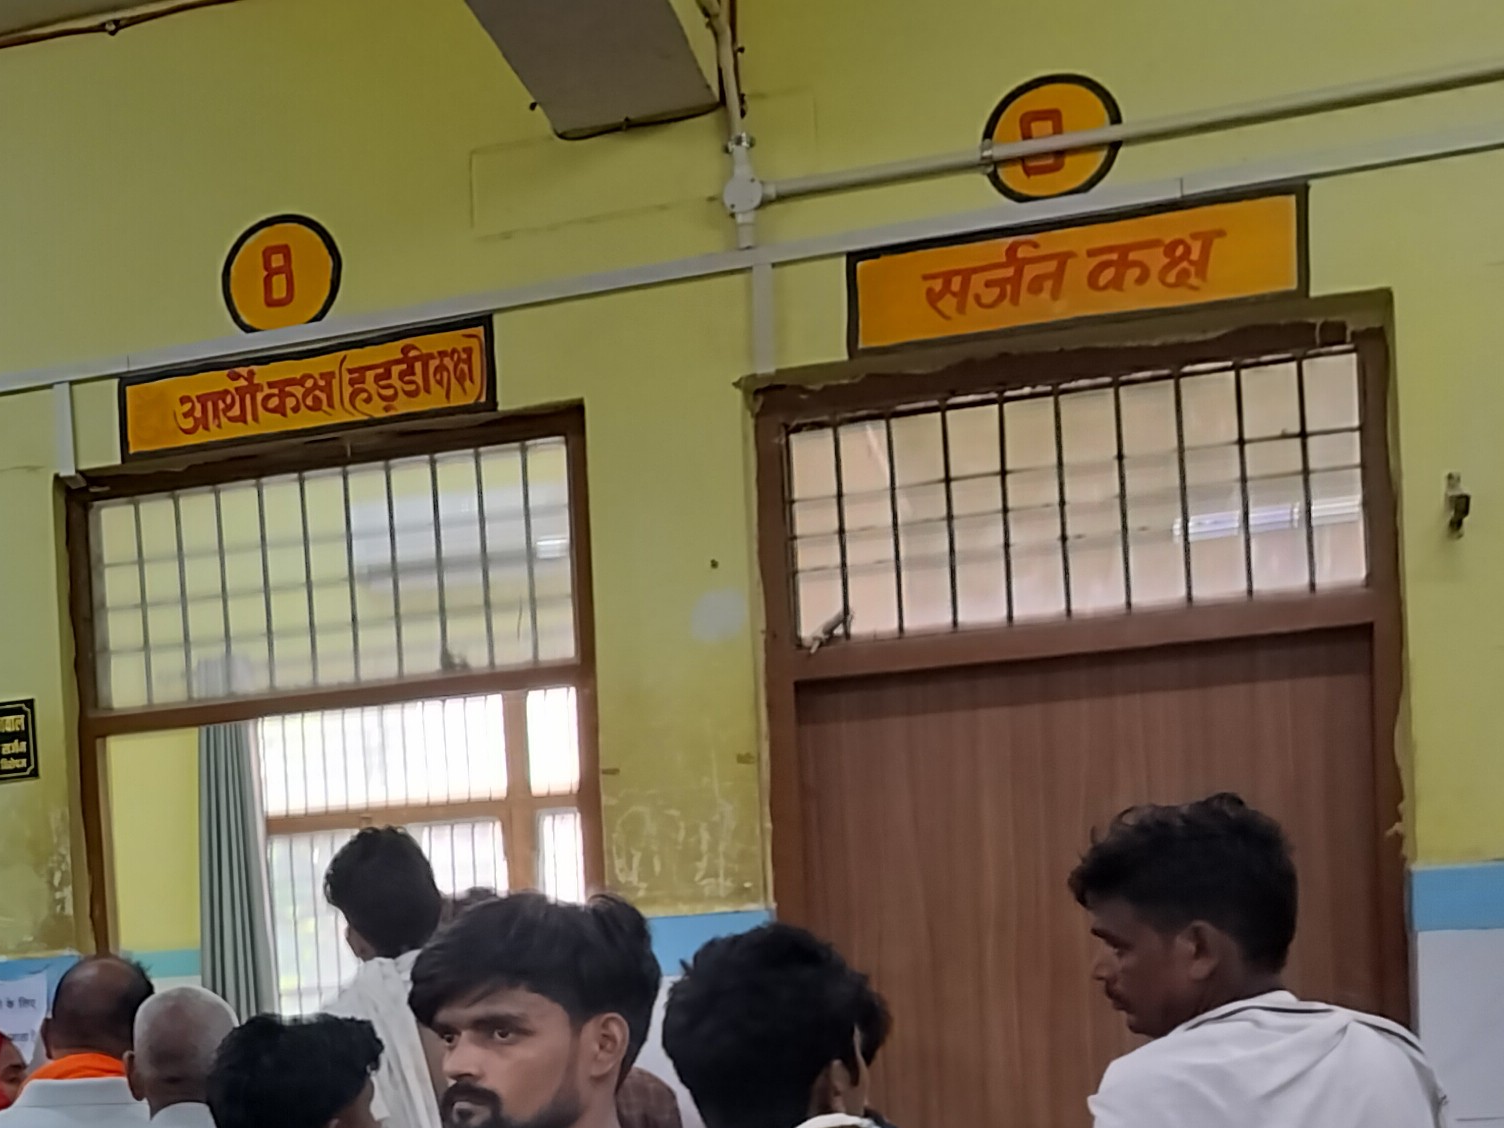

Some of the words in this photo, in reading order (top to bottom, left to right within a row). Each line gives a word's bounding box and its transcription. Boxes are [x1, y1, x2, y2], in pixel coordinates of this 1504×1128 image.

[262, 244, 295, 308] 8
[922, 239, 1078, 320] सर्जन
[1087, 228, 1227, 292] कक्ष
